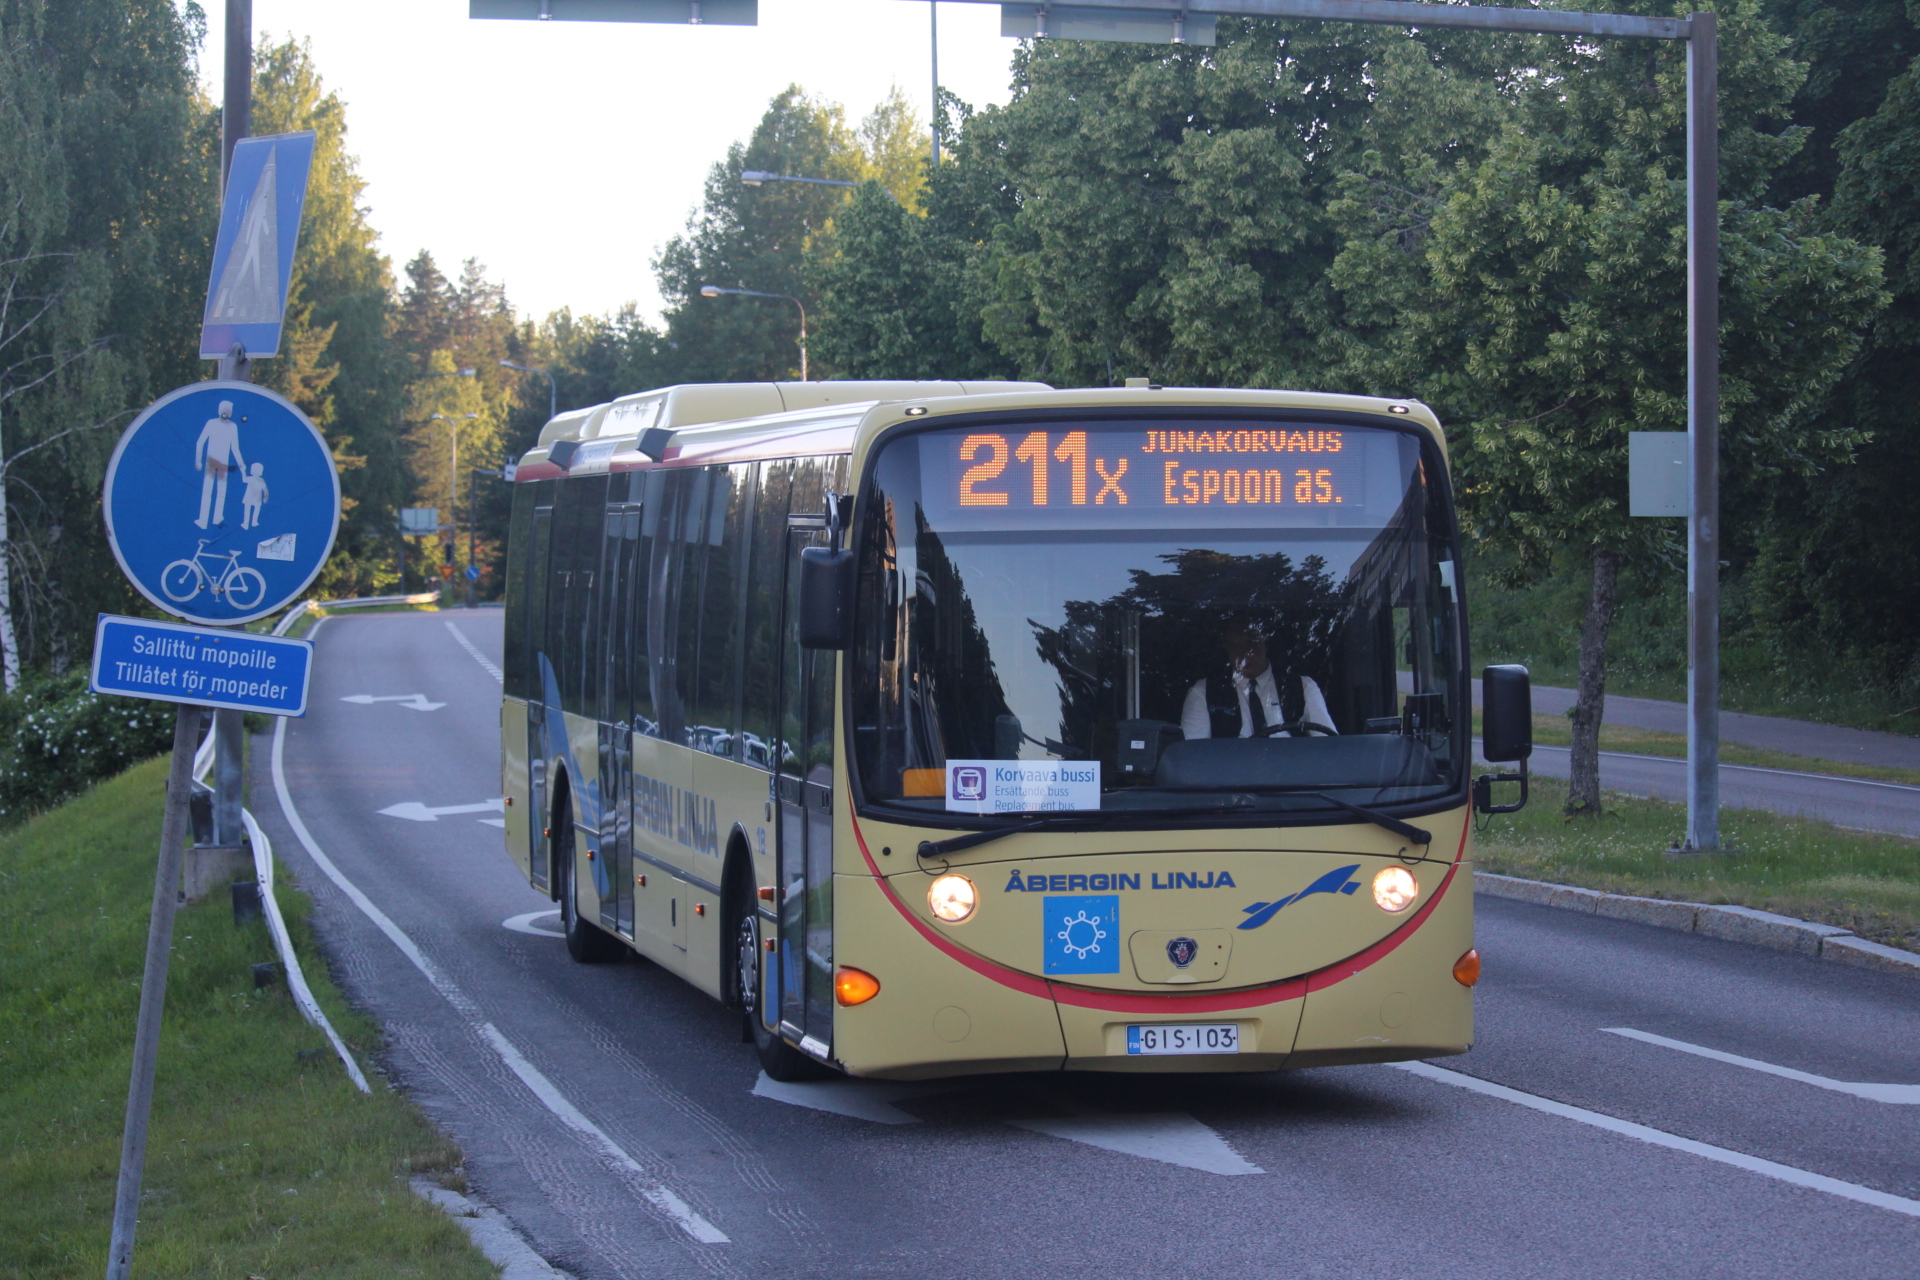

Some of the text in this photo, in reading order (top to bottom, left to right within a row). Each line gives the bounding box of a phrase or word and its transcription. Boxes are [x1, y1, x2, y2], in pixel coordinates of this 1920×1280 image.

[1142, 431, 1342, 453] JUNAKORVAUS
[1165, 461, 1342, 504] Espoon as.
[133, 634, 277, 670] Sallittu mopoille
[115, 661, 288, 700] Tillåtet för mopeder
[995, 768, 1095, 783] Korvaava bussi
[995, 785, 1069, 797] Ersättande buss
[995, 800, 1075, 811] Replacement bus
[677, 788, 719, 859] LINJA
[1004, 869, 1237, 893] ÅBERGIN LINJA
[1144, 1028, 1234, 1050] GIS-103
